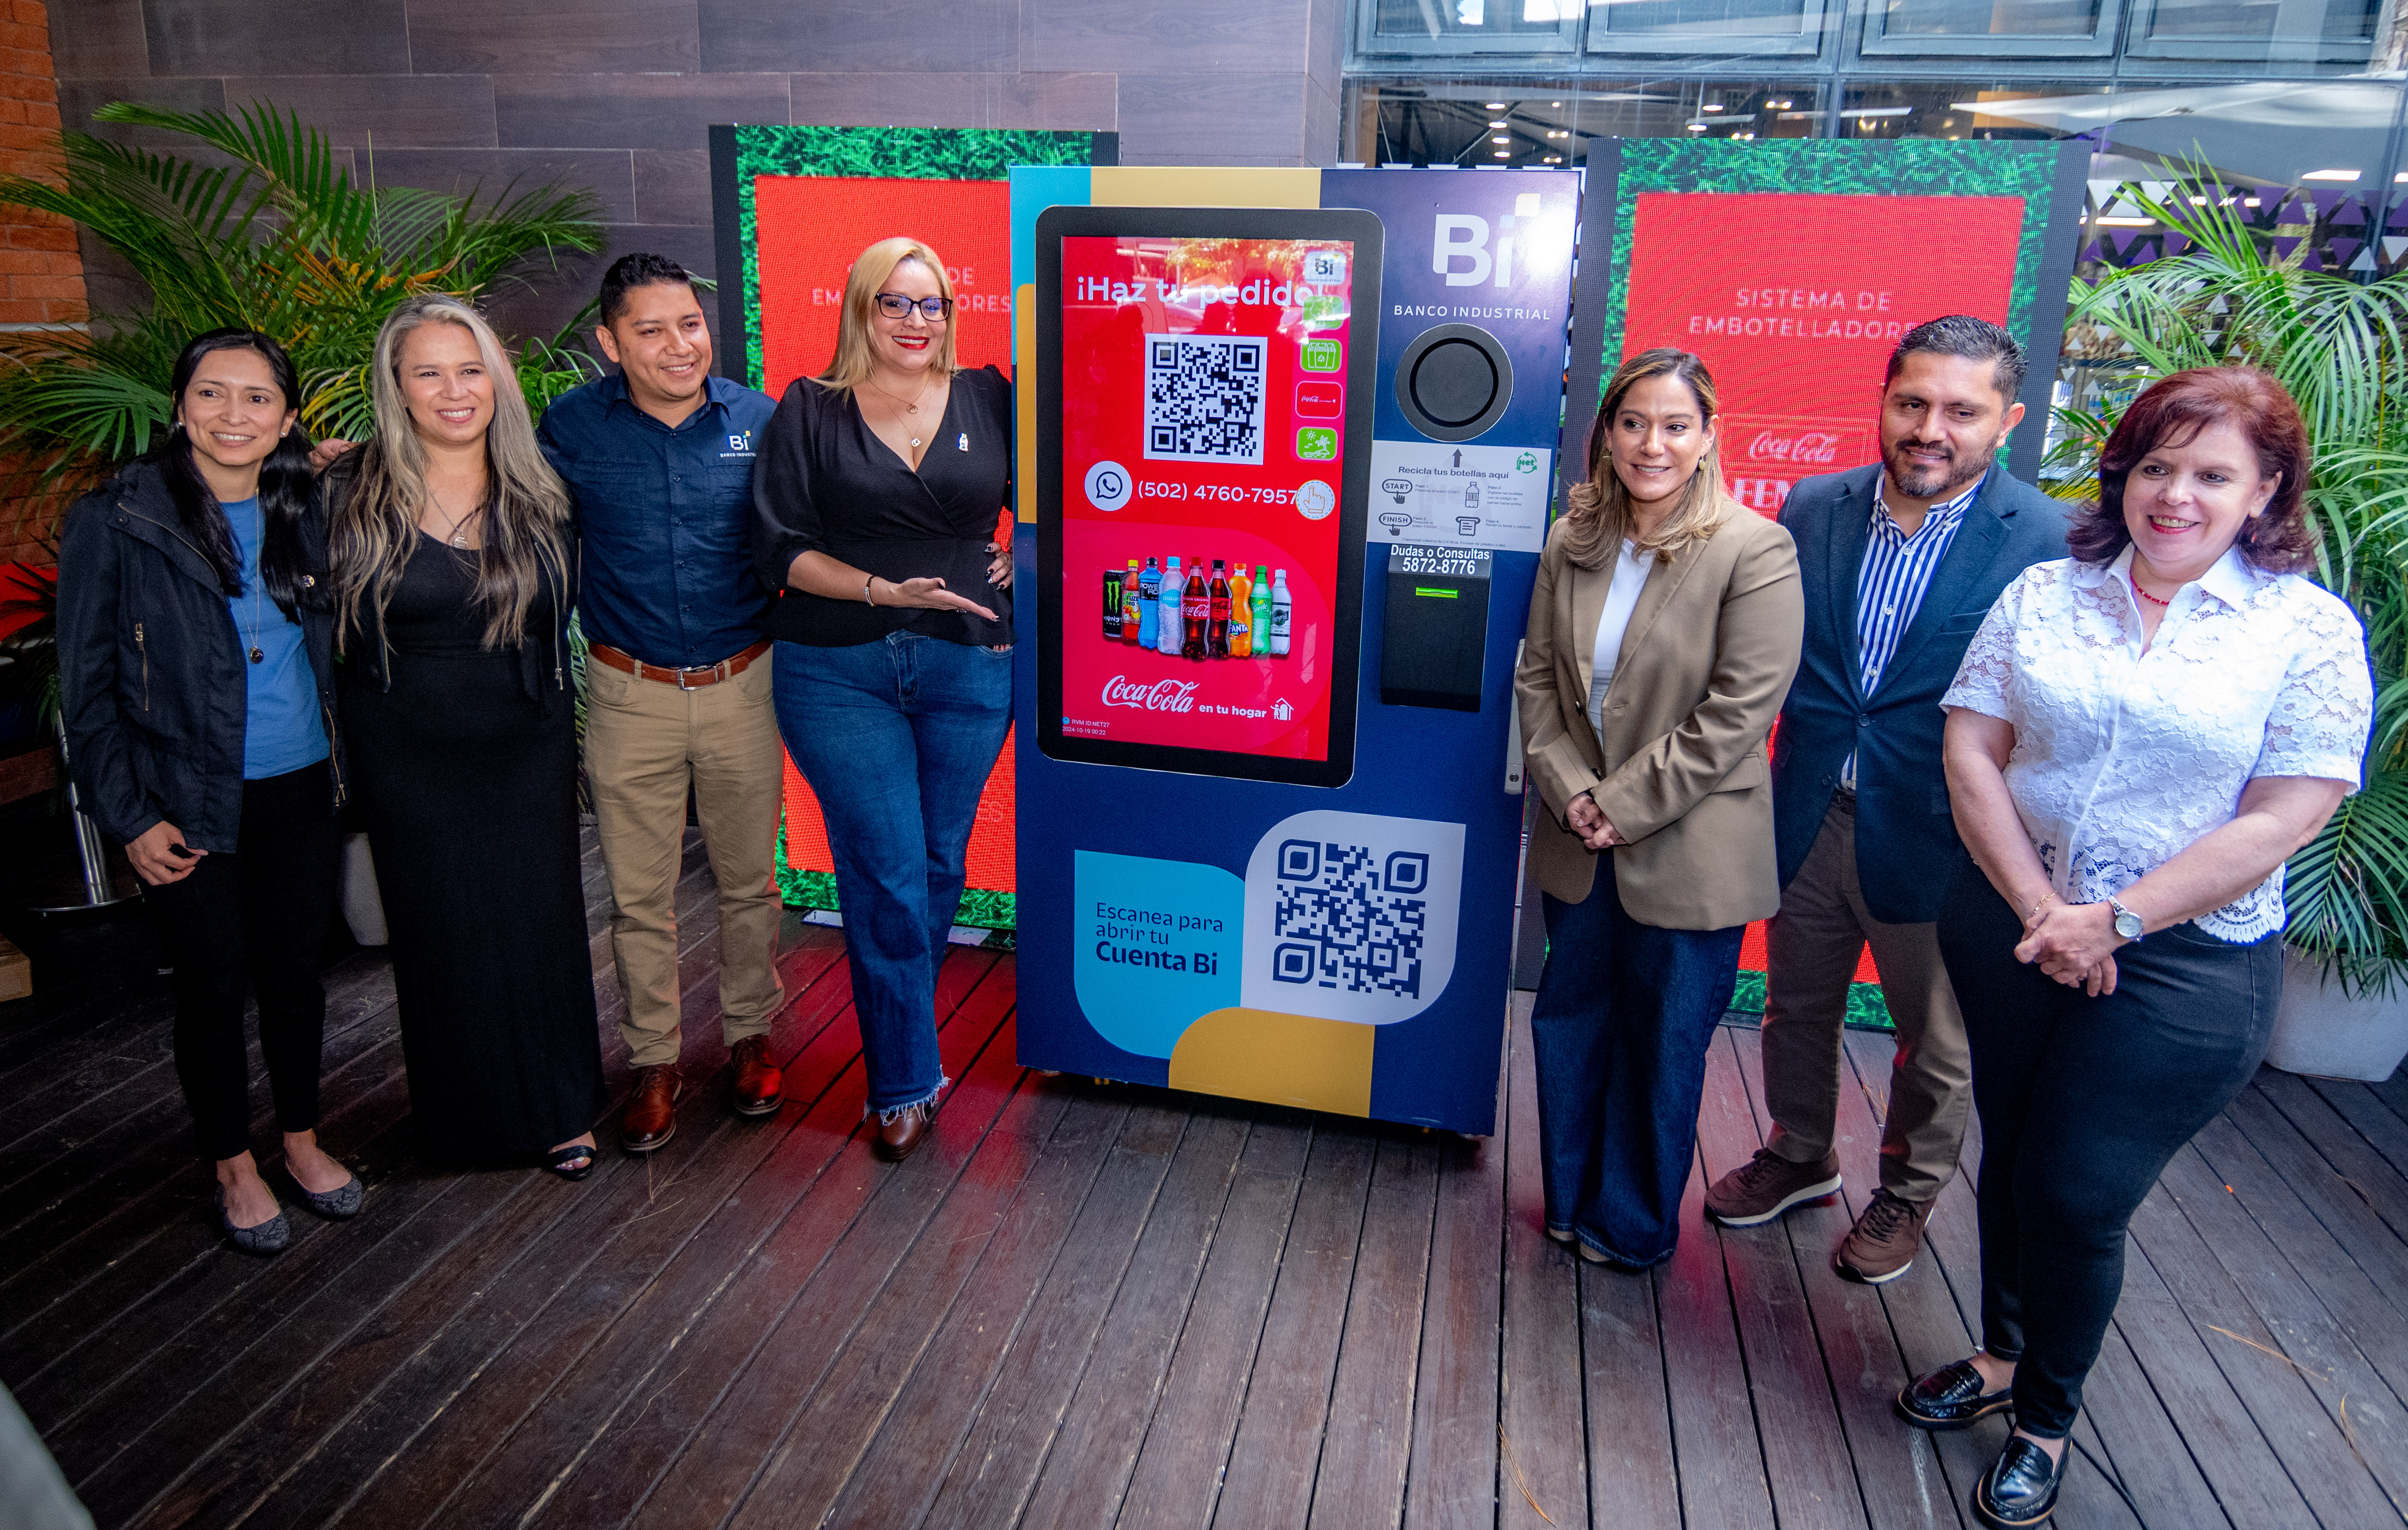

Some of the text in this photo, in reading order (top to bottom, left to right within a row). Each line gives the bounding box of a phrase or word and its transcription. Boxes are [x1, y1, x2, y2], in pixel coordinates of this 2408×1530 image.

[1432, 214, 1515, 288] Bi
[1315, 258, 1333, 275] Bi
[947, 267, 973, 285] DE
[1077, 276, 1146, 302] ¡Haz
[1156, 278, 1188, 303] tu
[1736, 288, 1891, 311] SISTEMA DE
[1393, 305, 1550, 320] BANCO INDUSTRIAL
[1690, 315, 1918, 340] EMBOTELLADOR
[729, 435, 749, 451] Bi
[1398, 466, 1432, 475] Recicla
[1450, 469, 1486, 478] botellas
[1488, 472, 1509, 480] aquí
[1139, 480, 1188, 501] (502)
[1193, 485, 1298, 505] 4760-7957
[1391, 544, 1490, 560] Dudas o Consultas
[1402, 557, 1476, 575] 5872-8776
[1181, 602, 1209, 617] Coca-Cola
[1101, 675, 1200, 713] Coca-Cola
[1199, 704, 1267, 719] en tu hogar
[1062, 726, 1091, 734] 2024-10-19
[1096, 902, 1223, 932] Escanea para
[1096, 922, 1169, 945] abrir tu
[1095, 941, 1218, 976] Cuenta Bi
